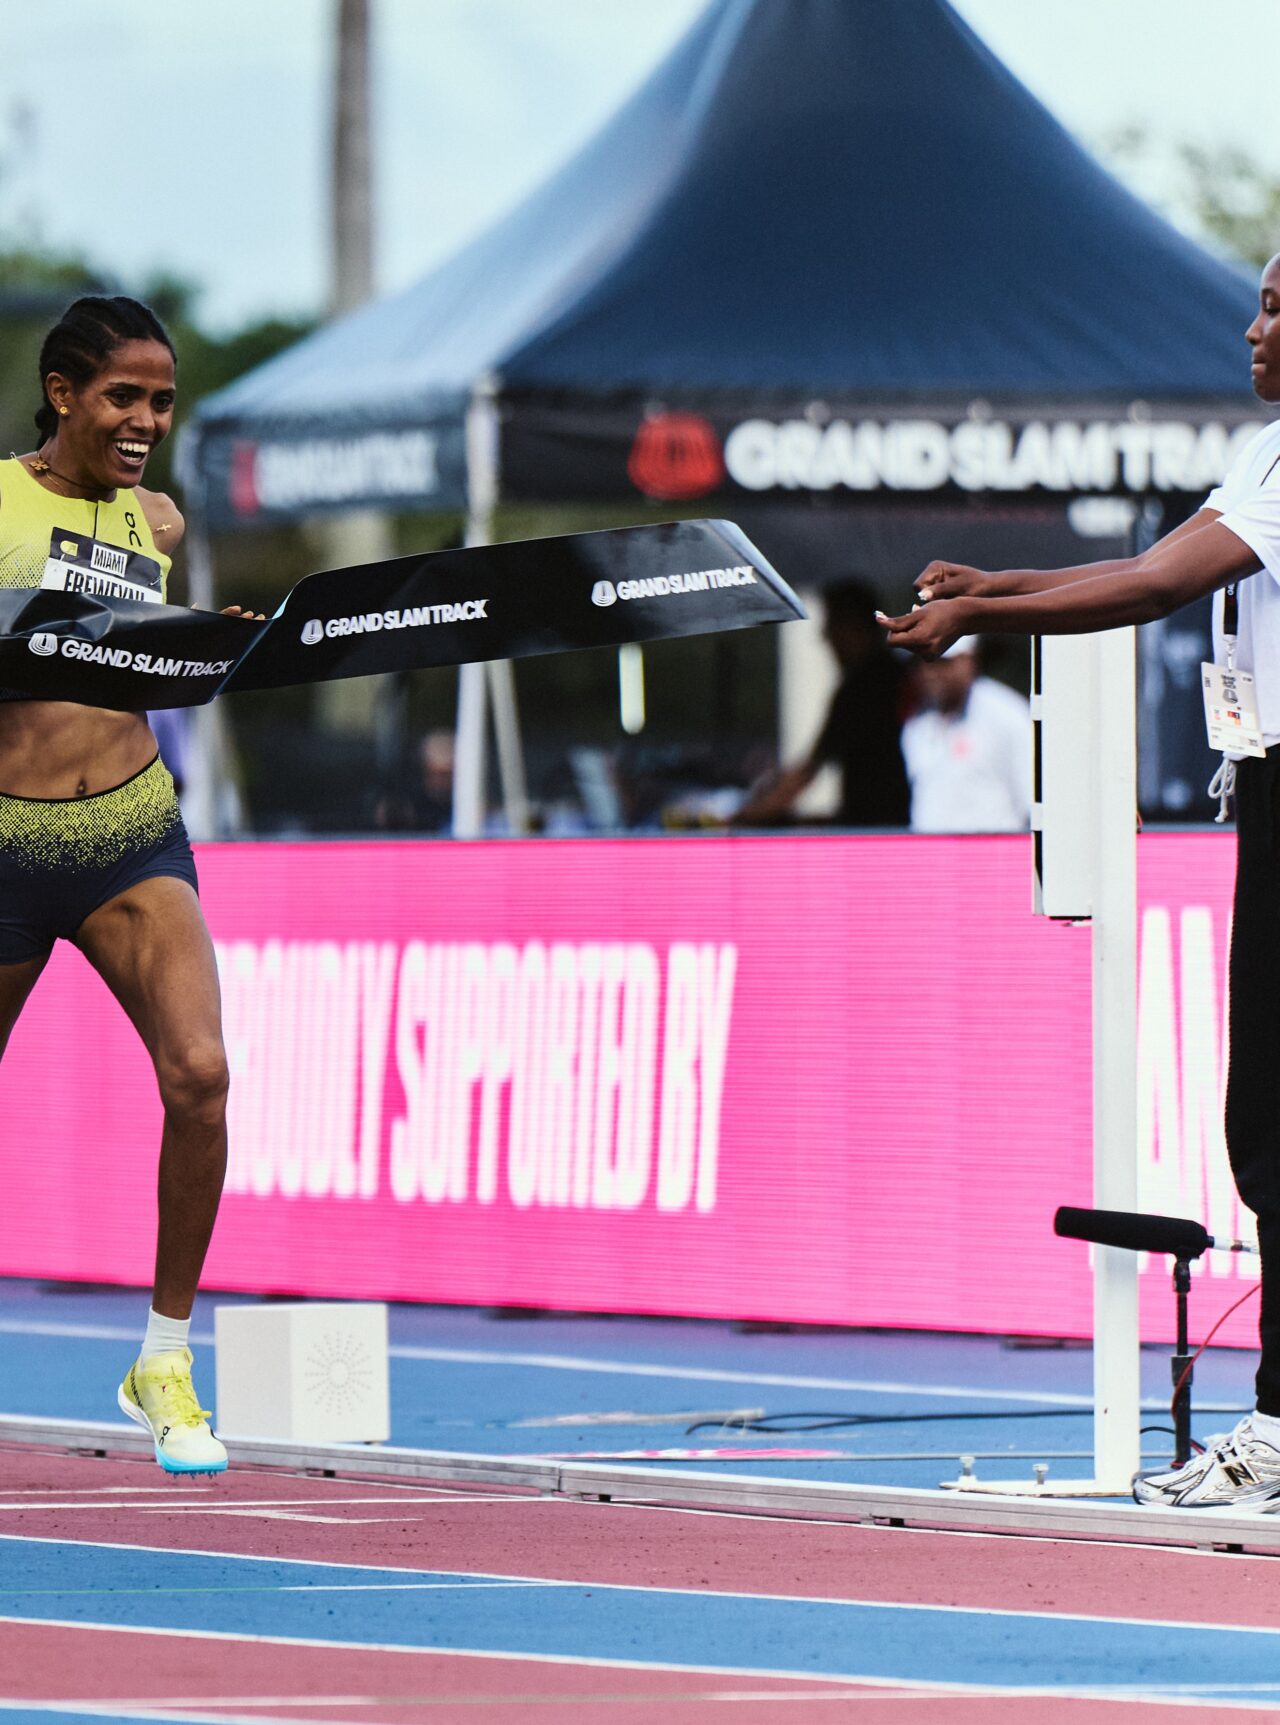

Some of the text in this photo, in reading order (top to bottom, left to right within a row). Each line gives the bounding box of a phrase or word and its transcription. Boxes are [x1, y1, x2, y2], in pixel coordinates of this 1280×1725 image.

[94, 548, 125, 575] MIAMI
[617, 566, 757, 600] GRAND SLAM TRACK
[325, 599, 489, 638] GRAND SLAM TRACK
[61, 640, 234, 677] GRAND SLAM TRACK
[657, 942, 738, 1213] BY
